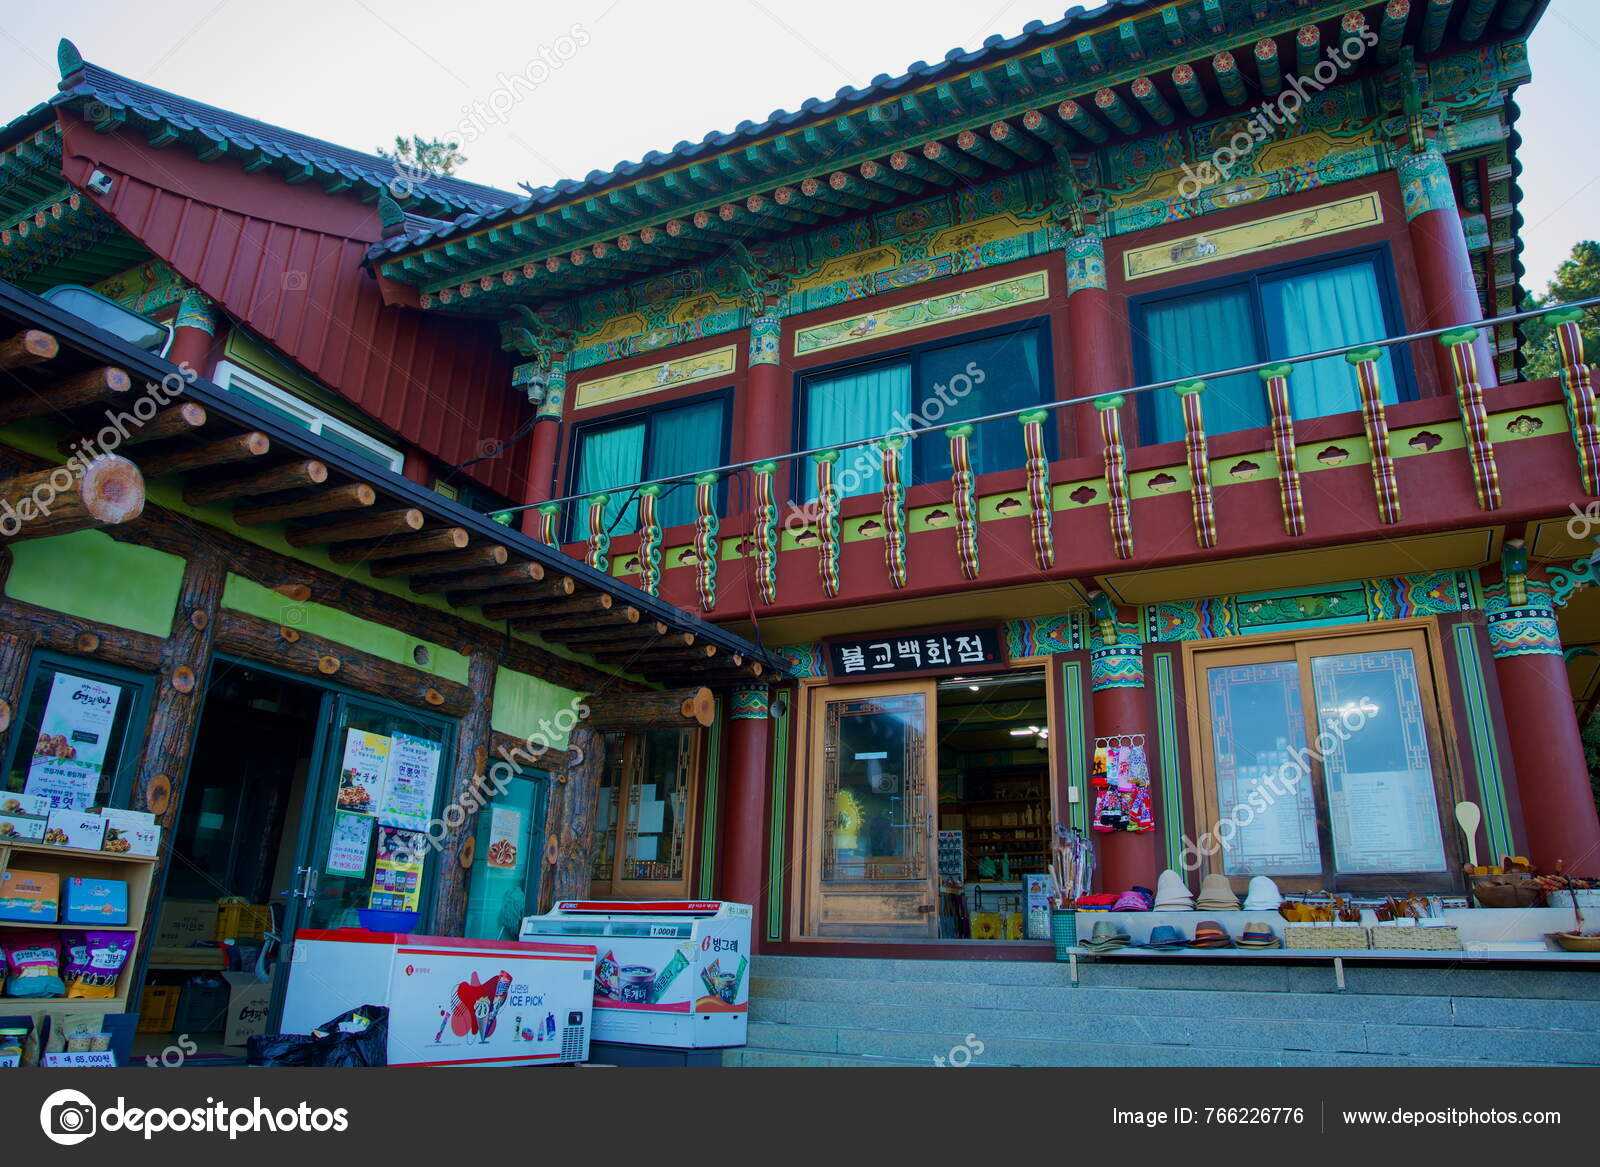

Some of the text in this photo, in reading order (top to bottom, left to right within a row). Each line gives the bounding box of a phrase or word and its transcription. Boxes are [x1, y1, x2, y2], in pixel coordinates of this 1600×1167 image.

[841, 634, 985, 673] 불교백화점
[712, 937, 738, 952] 빙그레
[510, 995, 544, 1007] ICE PICK
